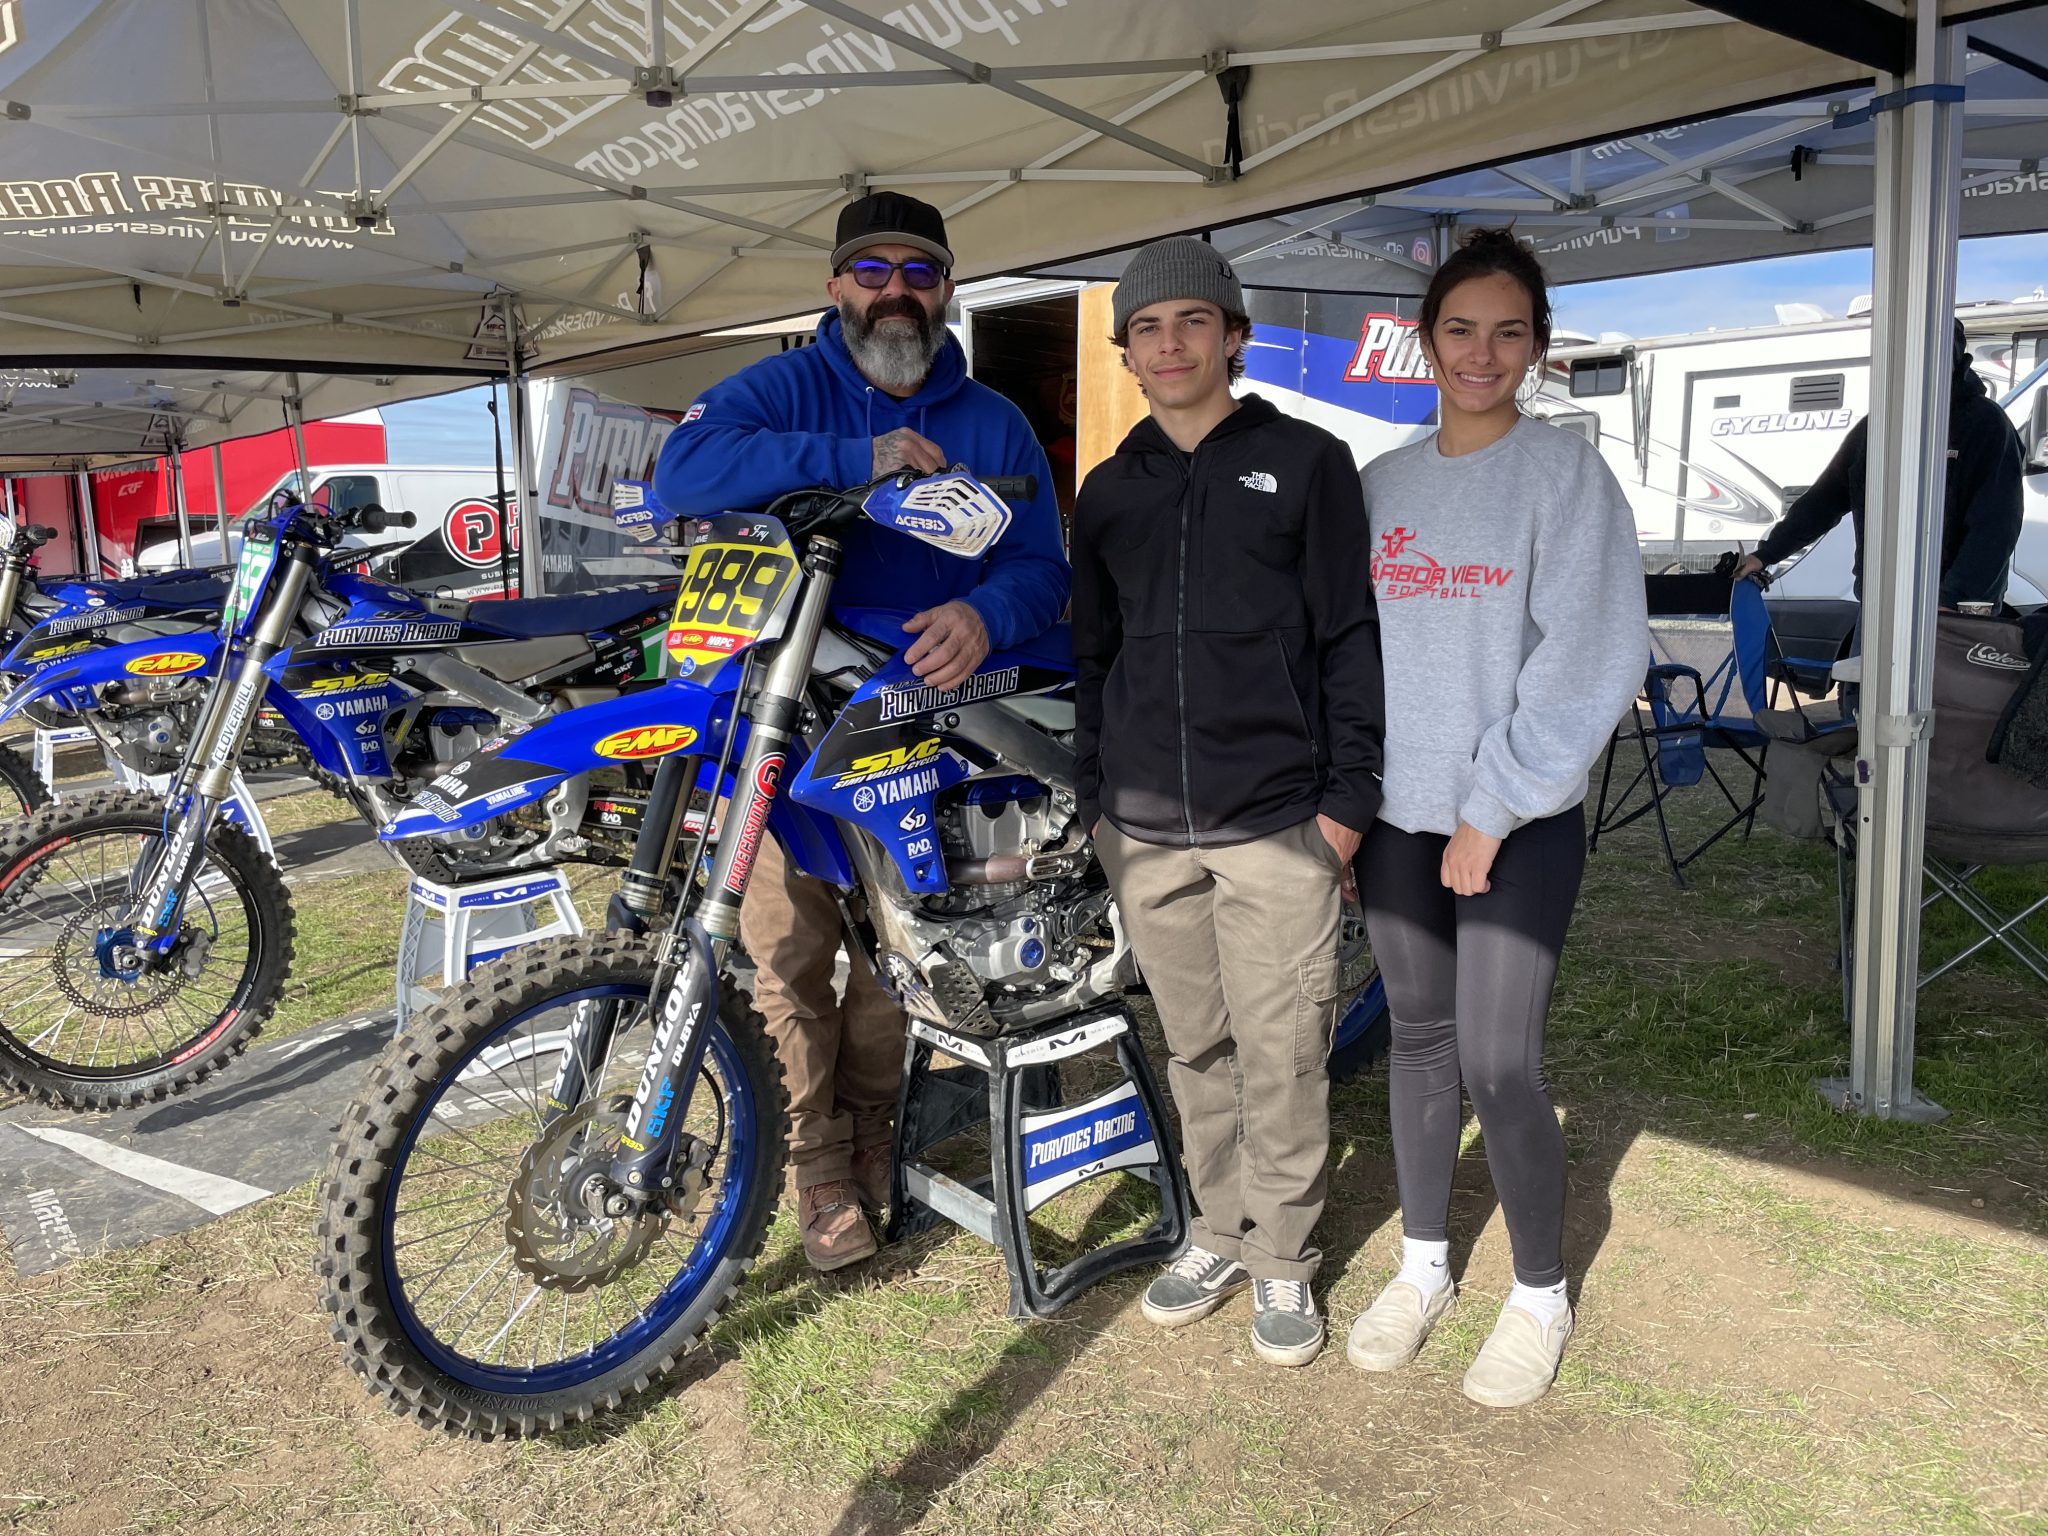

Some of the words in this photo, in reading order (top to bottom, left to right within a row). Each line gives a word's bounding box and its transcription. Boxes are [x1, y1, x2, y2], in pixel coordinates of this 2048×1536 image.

[1711, 409, 1852, 436] CYCLONE
[895, 514, 946, 532] ACERBIS
[333, 551, 371, 570] DUNLOP
[1451, 565, 1514, 587] VIEW
[1387, 584, 1481, 599] SOFTBALL
[130, 655, 202, 673] FMF
[336, 695, 389, 717] YAMAHA
[214, 682, 254, 762] CLOVERHILL
[601, 727, 692, 756] FMF
[832, 776, 866, 791] SIMI
[866, 764, 908, 782] VALLEY
[907, 753, 941, 770] CYCLES
[877, 768, 940, 805] YAMAHA
[487, 784, 528, 805] YAMALUBE
[727, 793, 769, 892] PRECISION
[142, 816, 188, 928] DUNLOP
[626, 961, 691, 1138] DUNLOP
[671, 1002, 703, 1068] DUBYA
[645, 1075, 676, 1138] SKF
